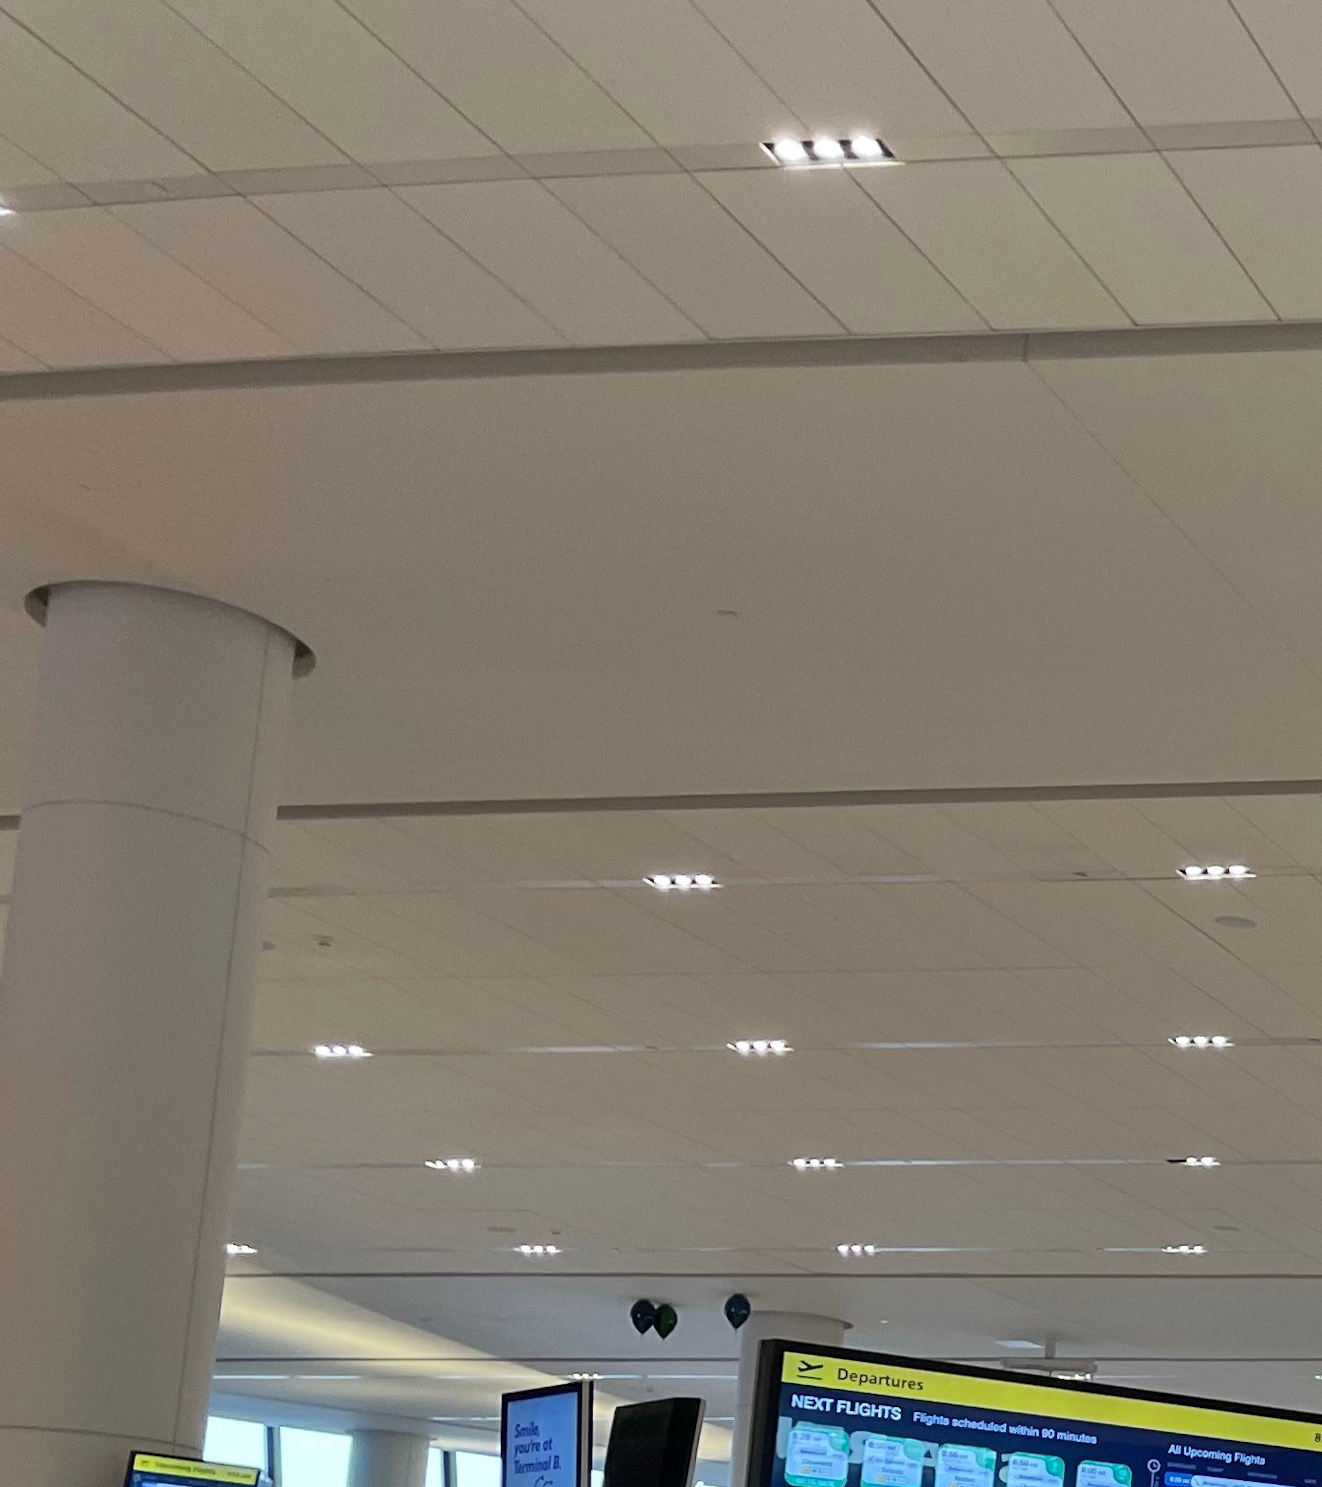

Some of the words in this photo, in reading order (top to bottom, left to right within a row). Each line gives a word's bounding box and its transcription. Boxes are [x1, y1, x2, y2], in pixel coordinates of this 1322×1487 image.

[837, 1368, 923, 1390] Departures
[791, 1394, 834, 1412] NEXT
[836, 1399, 902, 1421] FLIGHTS
[514, 1420, 540, 1438] Smile,
[913, 1411, 949, 1428] Flights
[952, 1417, 1006, 1433] scheduled
[1009, 1424, 1039, 1437] within
[1042, 1428, 1054, 1439] 90
[1057, 1431, 1097, 1445] minutes
[514, 1439, 541, 1456] you're
[543, 1439, 552, 1451] at
[1168, 1444, 1181, 1455] All
[1184, 1446, 1231, 1464] Upcoming
[1234, 1452, 1265, 1466] Flights
[514, 1456, 551, 1473] Terminal
[553, 1455, 561, 1470] B.
